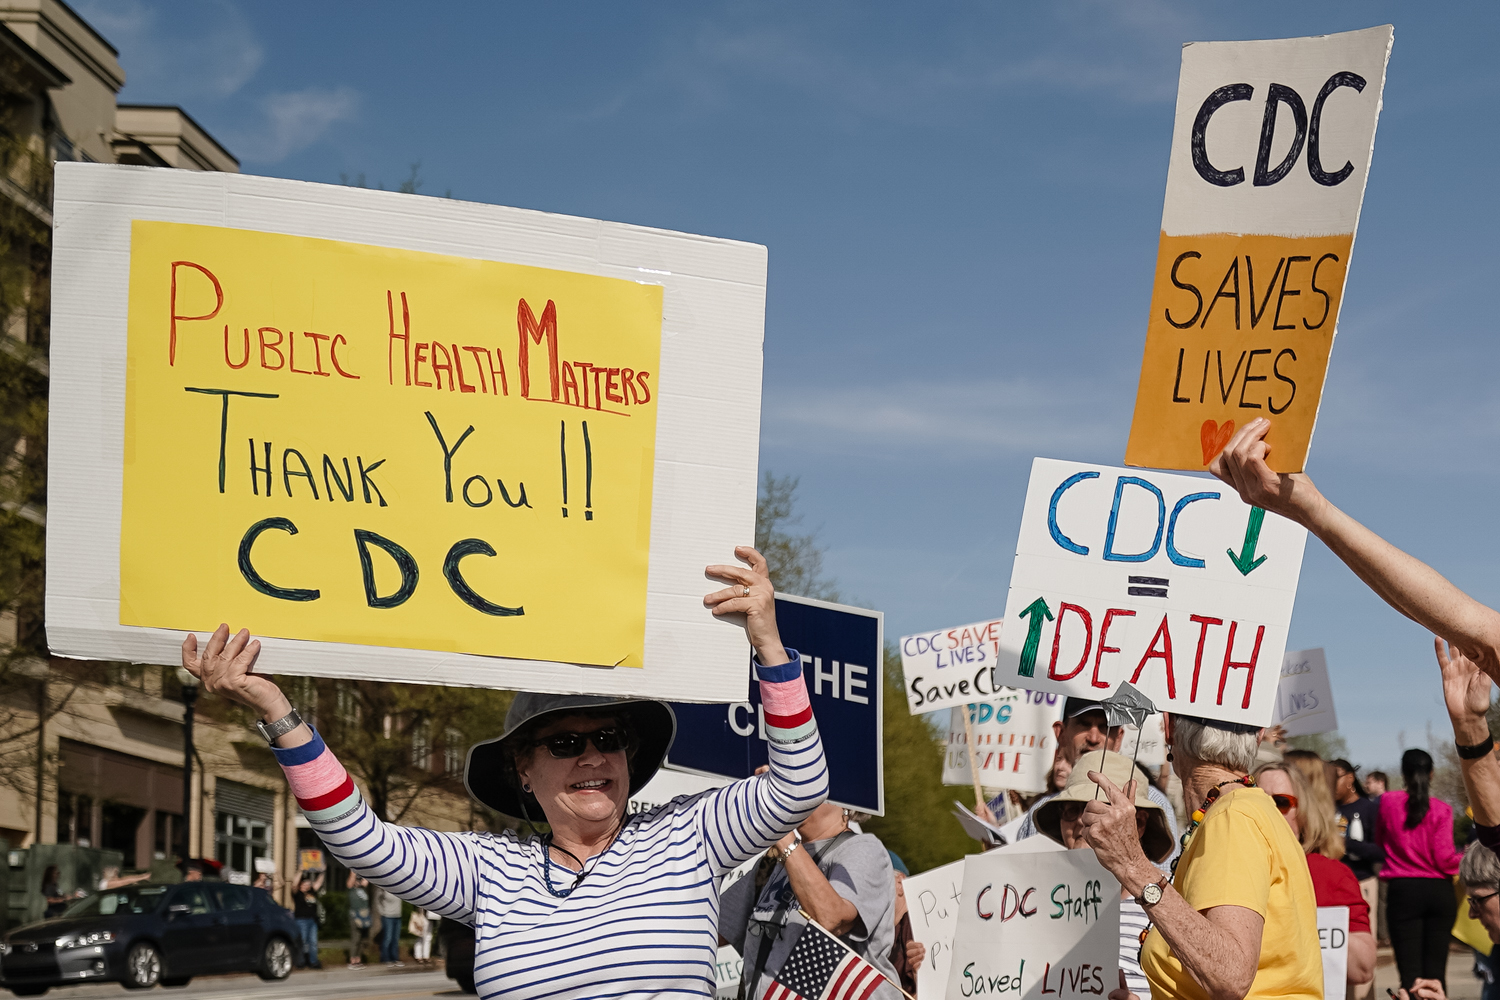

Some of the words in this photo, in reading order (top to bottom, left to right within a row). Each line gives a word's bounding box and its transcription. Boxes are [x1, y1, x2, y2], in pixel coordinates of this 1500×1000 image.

[1191, 71, 1367, 187] CDC
[1164, 250, 1339, 331] SAVES
[1173, 348, 1298, 414] LIVES
[1047, 471, 1220, 568] CDC
[238, 516, 525, 616] CDC
[904, 633, 942, 657] CDC
[948, 621, 1004, 649] SAVE
[937, 643, 986, 669] LIVES
[1047, 601, 1265, 709] DEATH
[911, 677, 970, 706] Save
[977, 883, 1038, 923] CDC
[1050, 880, 1102, 924] Staff
[961, 959, 1025, 997] Saved
[1041, 962, 1104, 998] LIVES
